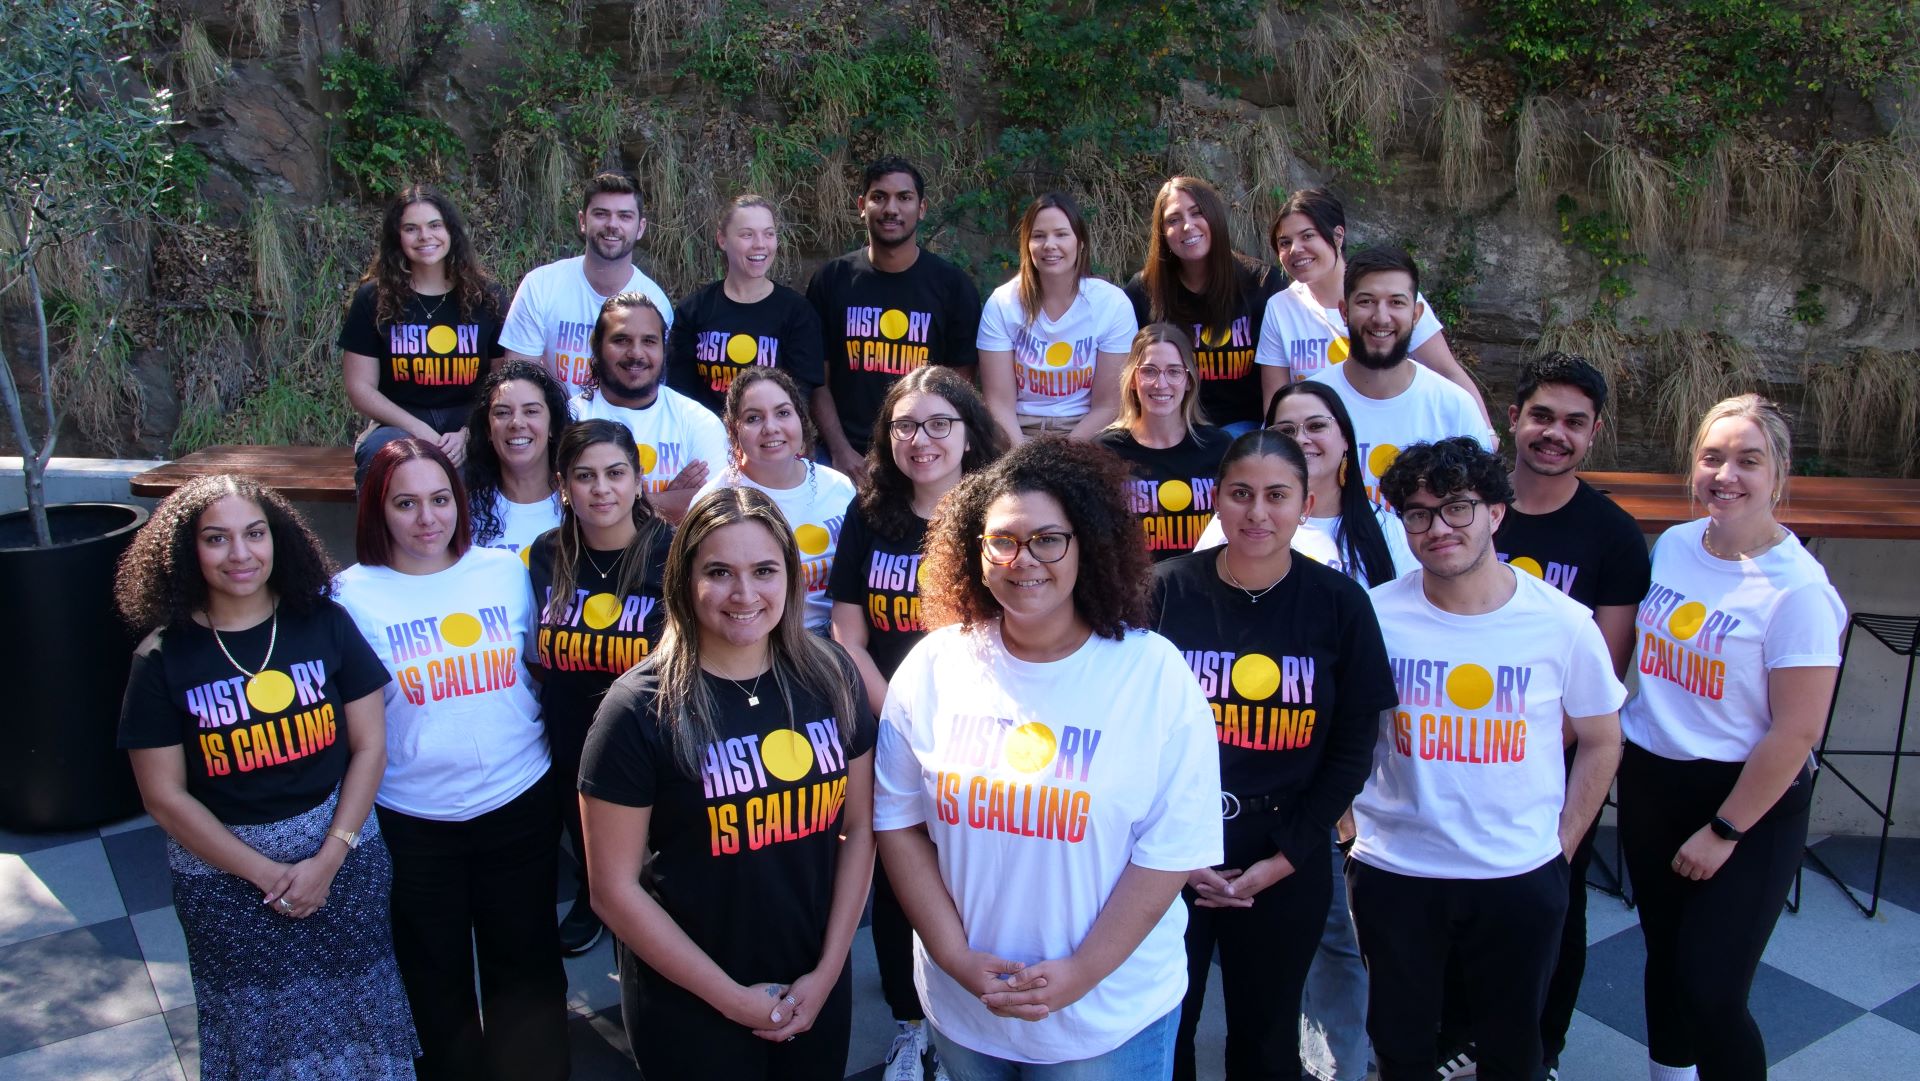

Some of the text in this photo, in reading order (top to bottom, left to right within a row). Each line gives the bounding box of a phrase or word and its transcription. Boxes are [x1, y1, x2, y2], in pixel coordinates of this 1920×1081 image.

[390, 324, 479, 355] HISTORY
[556, 320, 594, 353] HIST
[847, 306, 932, 343] HISTORY
[1014, 328, 1093, 364] HISTORY
[391, 356, 480, 386] IS CALLING
[556, 352, 570, 382] IS
[696, 331, 778, 368] HISTORY
[846, 340, 929, 375] IS CALLING
[1291, 336, 1350, 371] HISTO
[1028, 363, 1093, 397] CALLING
[868, 549, 926, 592] HIST
[385, 605, 513, 665] HISTORY
[869, 593, 890, 632] IS
[539, 628, 649, 675] IS CALLING
[1639, 632, 1726, 701] CALLING
[186, 659, 326, 728] HISTORY
[396, 646, 517, 706] IS CALLING
[1390, 657, 1532, 714] HISTORY
[199, 703, 337, 777] IS CALLING
[943, 713, 1102, 783] HISTORY
[1210, 702, 1317, 751] CALLING
[1392, 710, 1527, 765] IS CALLING
[699, 716, 848, 800] HISTORY
[706, 775, 849, 857] IS CALLING
[936, 770, 1091, 844] IS CALLING
